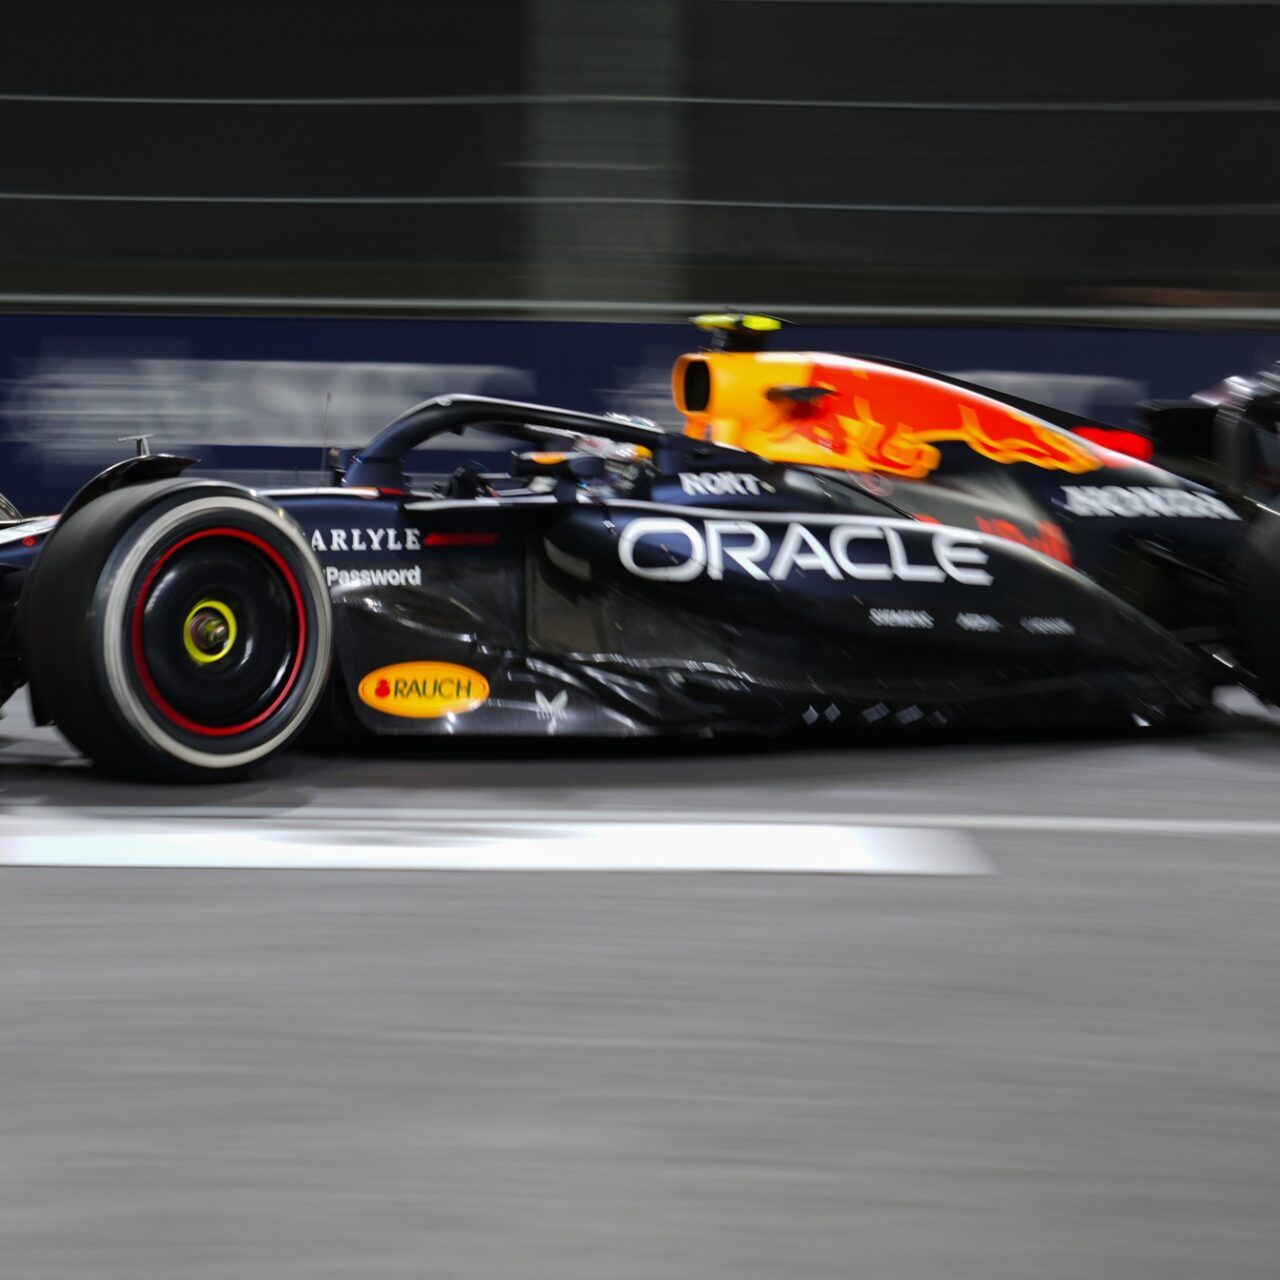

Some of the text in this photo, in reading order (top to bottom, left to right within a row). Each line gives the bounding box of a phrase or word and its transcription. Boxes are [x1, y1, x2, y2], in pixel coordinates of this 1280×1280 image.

[302, 528, 421, 551] ARLYLE
[618, 518, 994, 586] ORACLE
[323, 565, 422, 586] Password
[393, 678, 472, 699] RAUCH
